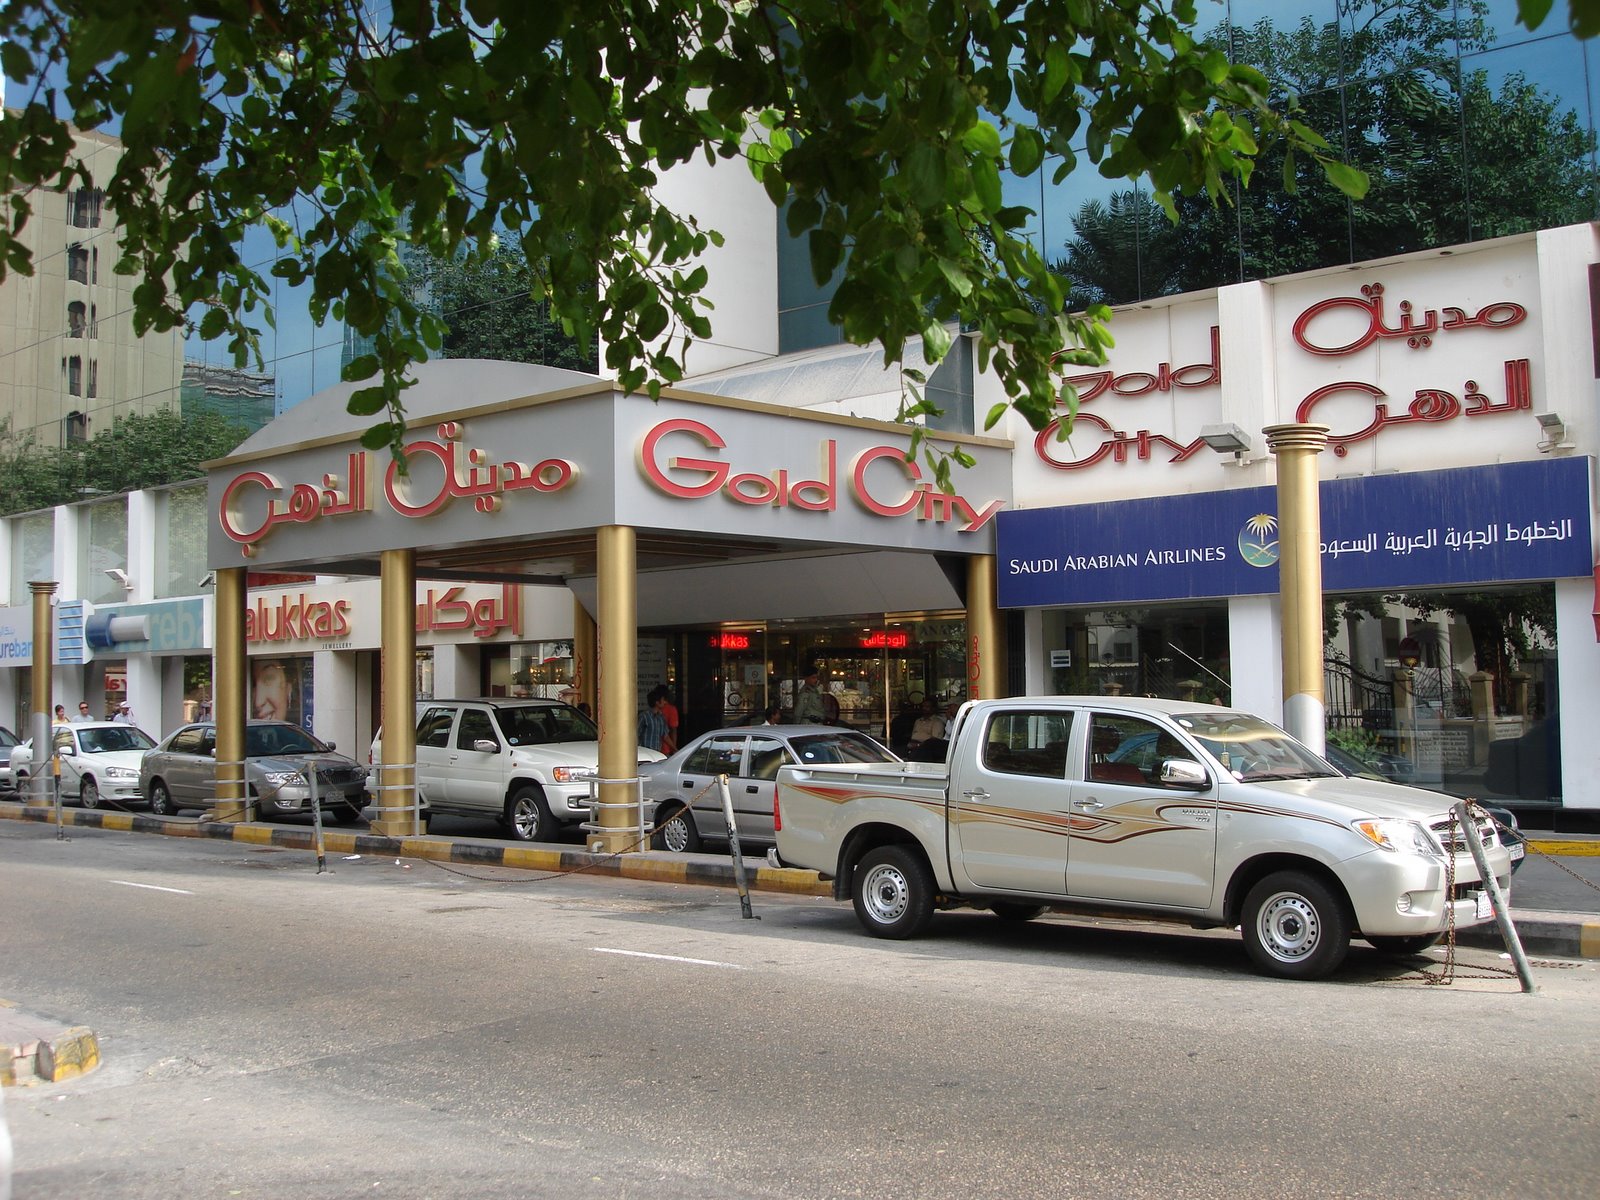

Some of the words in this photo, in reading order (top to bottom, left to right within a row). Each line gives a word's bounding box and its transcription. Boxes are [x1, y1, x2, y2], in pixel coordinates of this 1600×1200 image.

[1292, 282, 1528, 356] مدينة
[1296, 358, 1532, 457] الذهب
[384, 422, 580, 518] مدينة
[1034, 412, 1207, 470] City
[219, 450, 372, 559] الذهب
[636, 418, 837, 512] Gold
[848, 445, 1006, 532] City
[1009, 558, 1059, 575] SAUDI
[1063, 552, 1139, 572] ARABIAN
[1144, 546, 1226, 566] AIRLINES
[1384, 528, 1438, 556] العربية
[1444, 523, 1498, 551] الجوية
[1504, 518, 1573, 547] الخطوط
